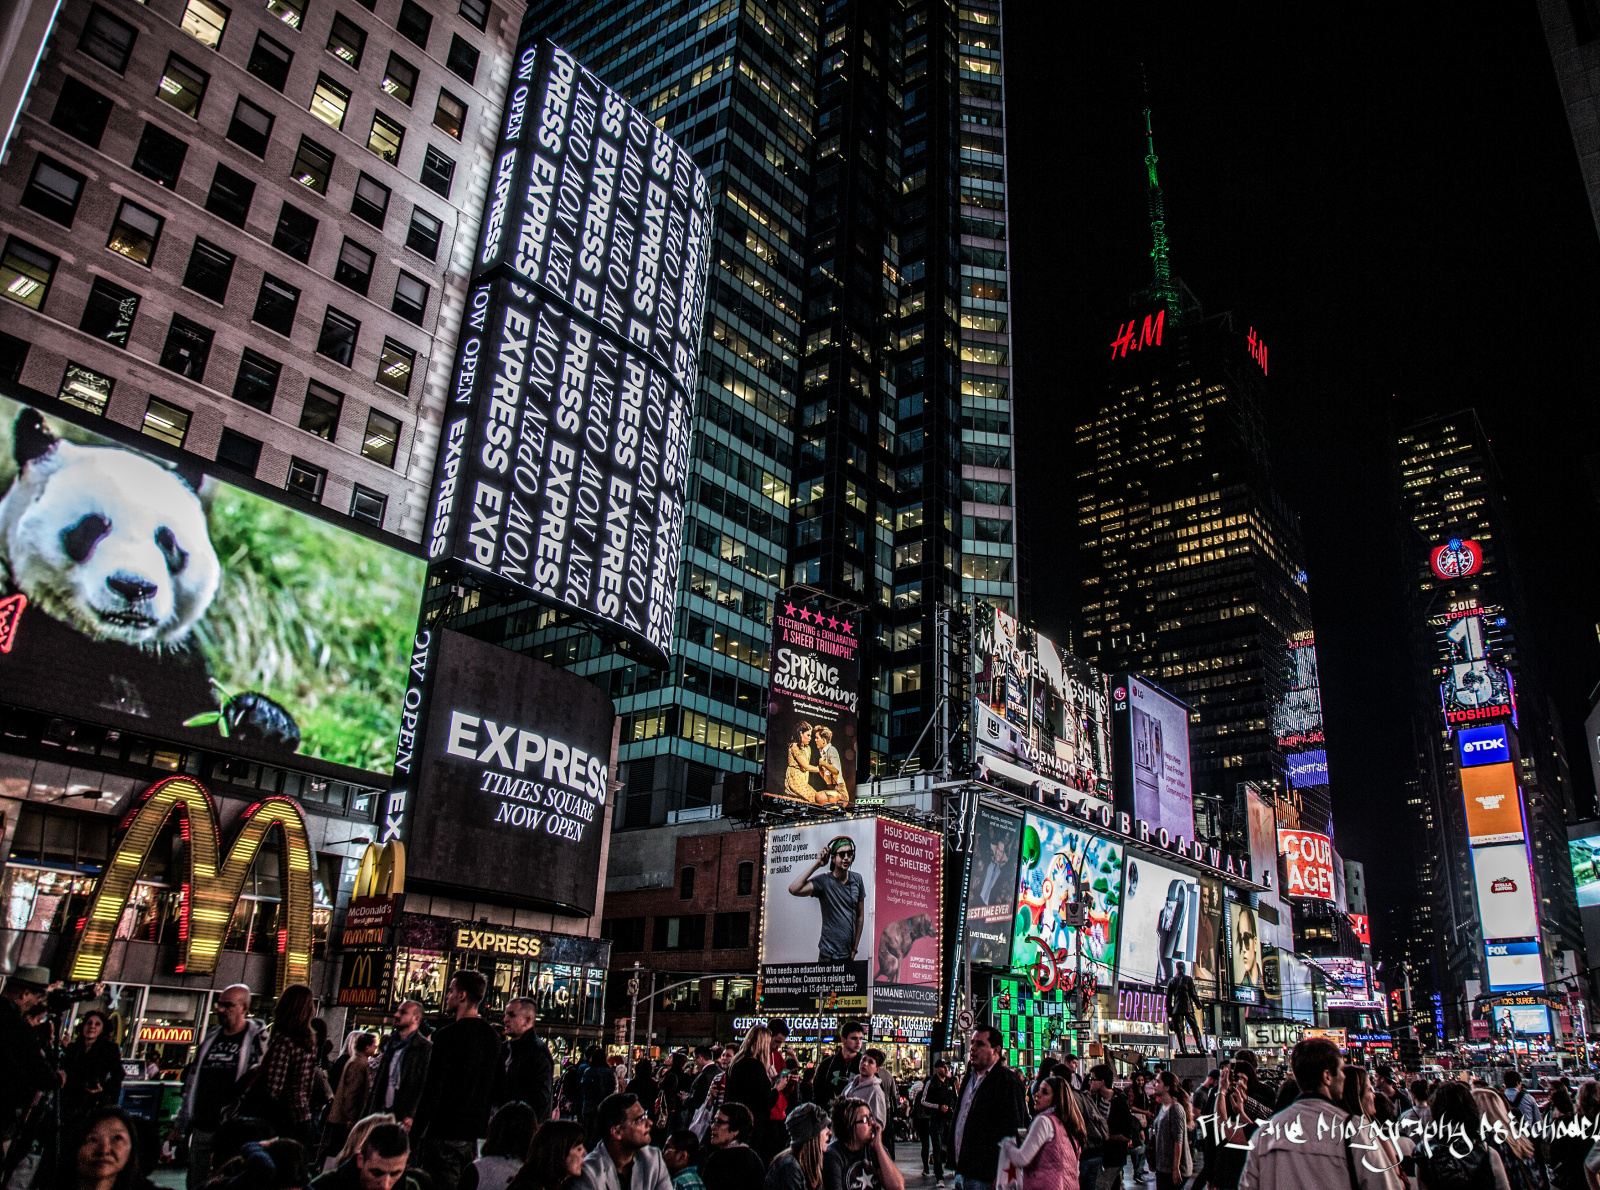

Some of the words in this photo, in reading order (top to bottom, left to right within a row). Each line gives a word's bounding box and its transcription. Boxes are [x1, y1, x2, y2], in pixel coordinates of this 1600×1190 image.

[518, 47, 536, 81] OW
[506, 85, 529, 141] OPEN
[567, 82, 598, 162] OPEN
[556, 155, 585, 236] NOW
[619, 138, 644, 215] NOW
[482, 148, 517, 264] EXPRESS
[515, 154, 556, 281] EXPRESS
[578, 138, 618, 277] EXPRESS
[545, 229, 575, 300] PEN
[607, 208, 635, 290] OPEN
[633, 181, 666, 316] EXPRESS
[663, 200, 686, 279] OPEN
[678, 208, 702, 339] EXPRESS
[656, 272, 676, 351] NOW
[1110, 309, 1165, 361] H&M
[456, 338, 481, 404] OPEN
[528, 311, 560, 402] NOW
[1247, 326, 1268, 377] H&M
[482, 306, 531, 474] EXPRESS
[586, 362, 615, 453] OPEN
[513, 396, 550, 495] OPEN
[637, 427, 660, 512] NOW
[429, 417, 467, 558] EXPRESS
[574, 450, 604, 542] NOW
[596, 475, 632, 620] EXPRES
[627, 510, 652, 604] OPEN
[646, 491, 674, 647] EXPRESS
[1445, 607, 1485, 620] TOSHIBA
[1450, 599, 1478, 612] 2015
[783, 629, 789, 642] A
[790, 630, 814, 649] SHEER
[980, 627, 1046, 683] MARQUEE
[774, 672, 858, 713] awakening
[1115, 702, 1127, 711] LG
[1138, 690, 1144, 699] LG
[1447, 704, 1511, 723] TOSHIBA
[395, 688, 421, 773] OPEN
[1473, 738, 1506, 752] TDK
[446, 710, 608, 806] EXPRESS
[1022, 742, 1076, 777] VORNADO
[480, 770, 543, 804] TIMES
[543, 787, 596, 822] SQUARE
[494, 802, 546, 830] NOW
[546, 814, 585, 843] OPEN
[772, 833, 788, 843] What?
[791, 833, 801, 842] get
[796, 844, 808, 852] year
[884, 825, 902, 839] HSUS
[904, 831, 933, 847] DOESN'T
[1119, 812, 1248, 878] BROADWAY
[770, 855, 781, 864] with
[790, 853, 818, 863] experience
[776, 865, 792, 874] skills?
[882, 839, 899, 852] GIVE
[901, 844, 923, 858] SQUAT
[924, 850, 934, 861] TO
[885, 854, 898, 865] PET
[900, 858, 931, 874] SHELTERS
[348, 904, 392, 917] McDonald's
[967, 908, 980, 919] BEST
[981, 905, 994, 917] TIME
[994, 904, 1009, 915] EVER
[456, 929, 541, 957] EXPRESS
[1488, 945, 1508, 956] FOX
[765, 986, 787, 994] minimum
[788, 986, 801, 995] wage
[802, 985, 808, 993] to
[809, 985, 815, 993] 15
[841, 983, 857, 992] hour?
[778, 976, 791, 984] when
[803, 975, 821, 983] Cuomo
[827, 974, 845, 984] raising
[846, 974, 856, 982] the
[800, 965, 825, 974] education
[833, 964, 844, 973] hard
[873, 986, 938, 1002] HUMANEWATCH.ORG
[785, 1017, 838, 1030] UGGAGE
[870, 1016, 894, 1029] GIFTS
[899, 1018, 934, 1031] LUGGAGE
[1118, 990, 1167, 1023] FOREVER
